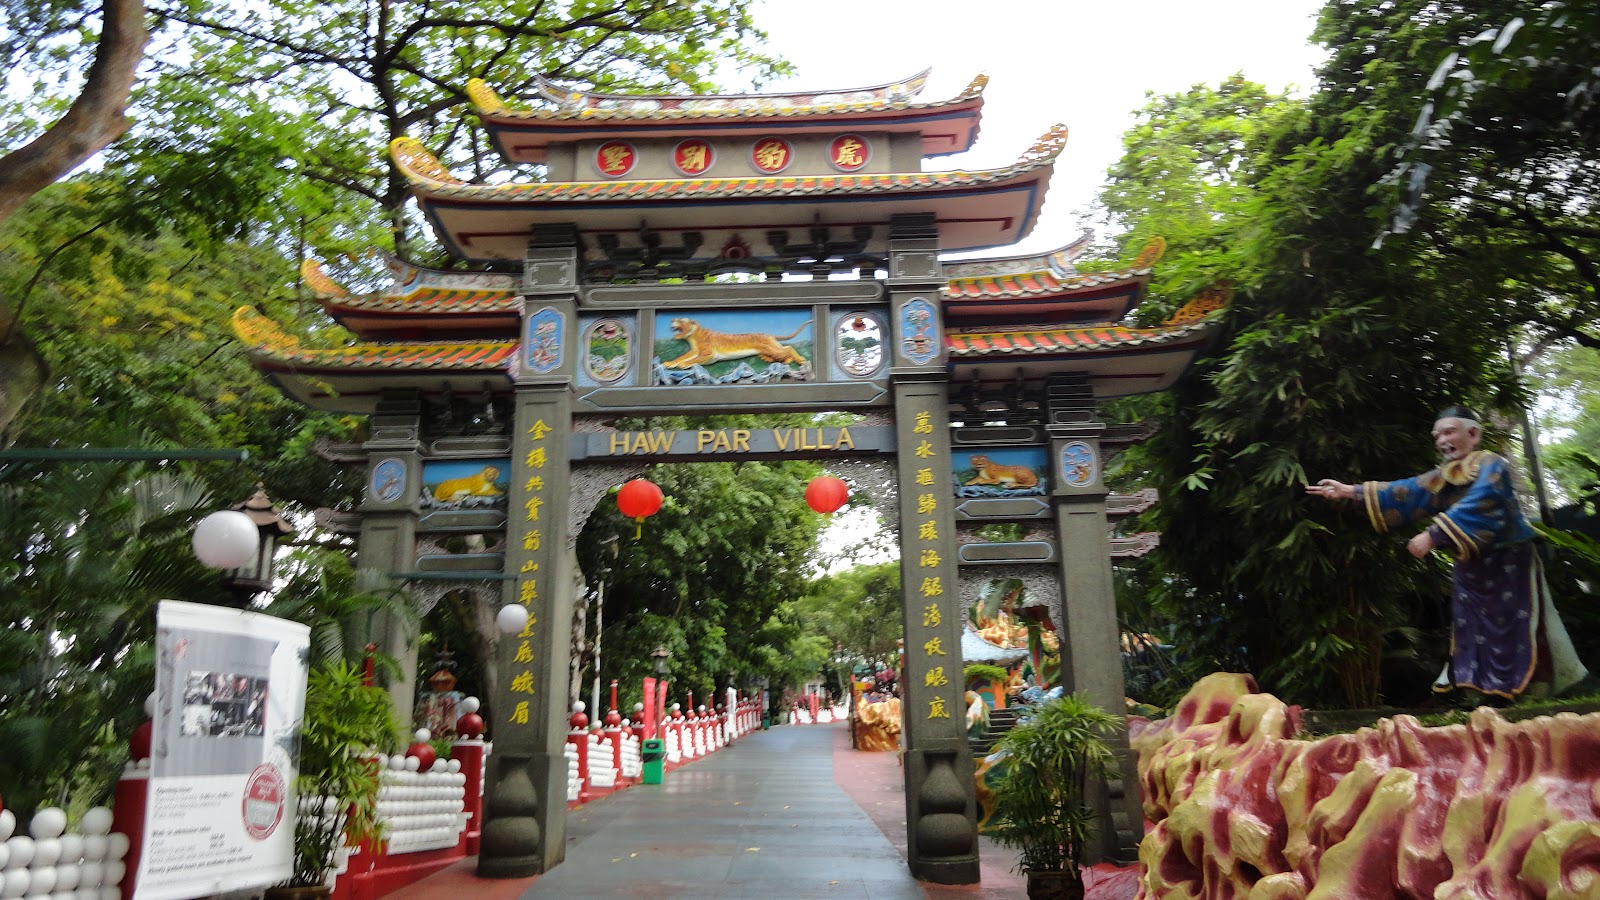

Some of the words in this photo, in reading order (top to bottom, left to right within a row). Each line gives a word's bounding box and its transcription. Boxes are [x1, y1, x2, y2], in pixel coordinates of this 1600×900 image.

[609, 430, 677, 455] HAW
[696, 428, 751, 452] PAR
[773, 427, 855, 451] VILLA
